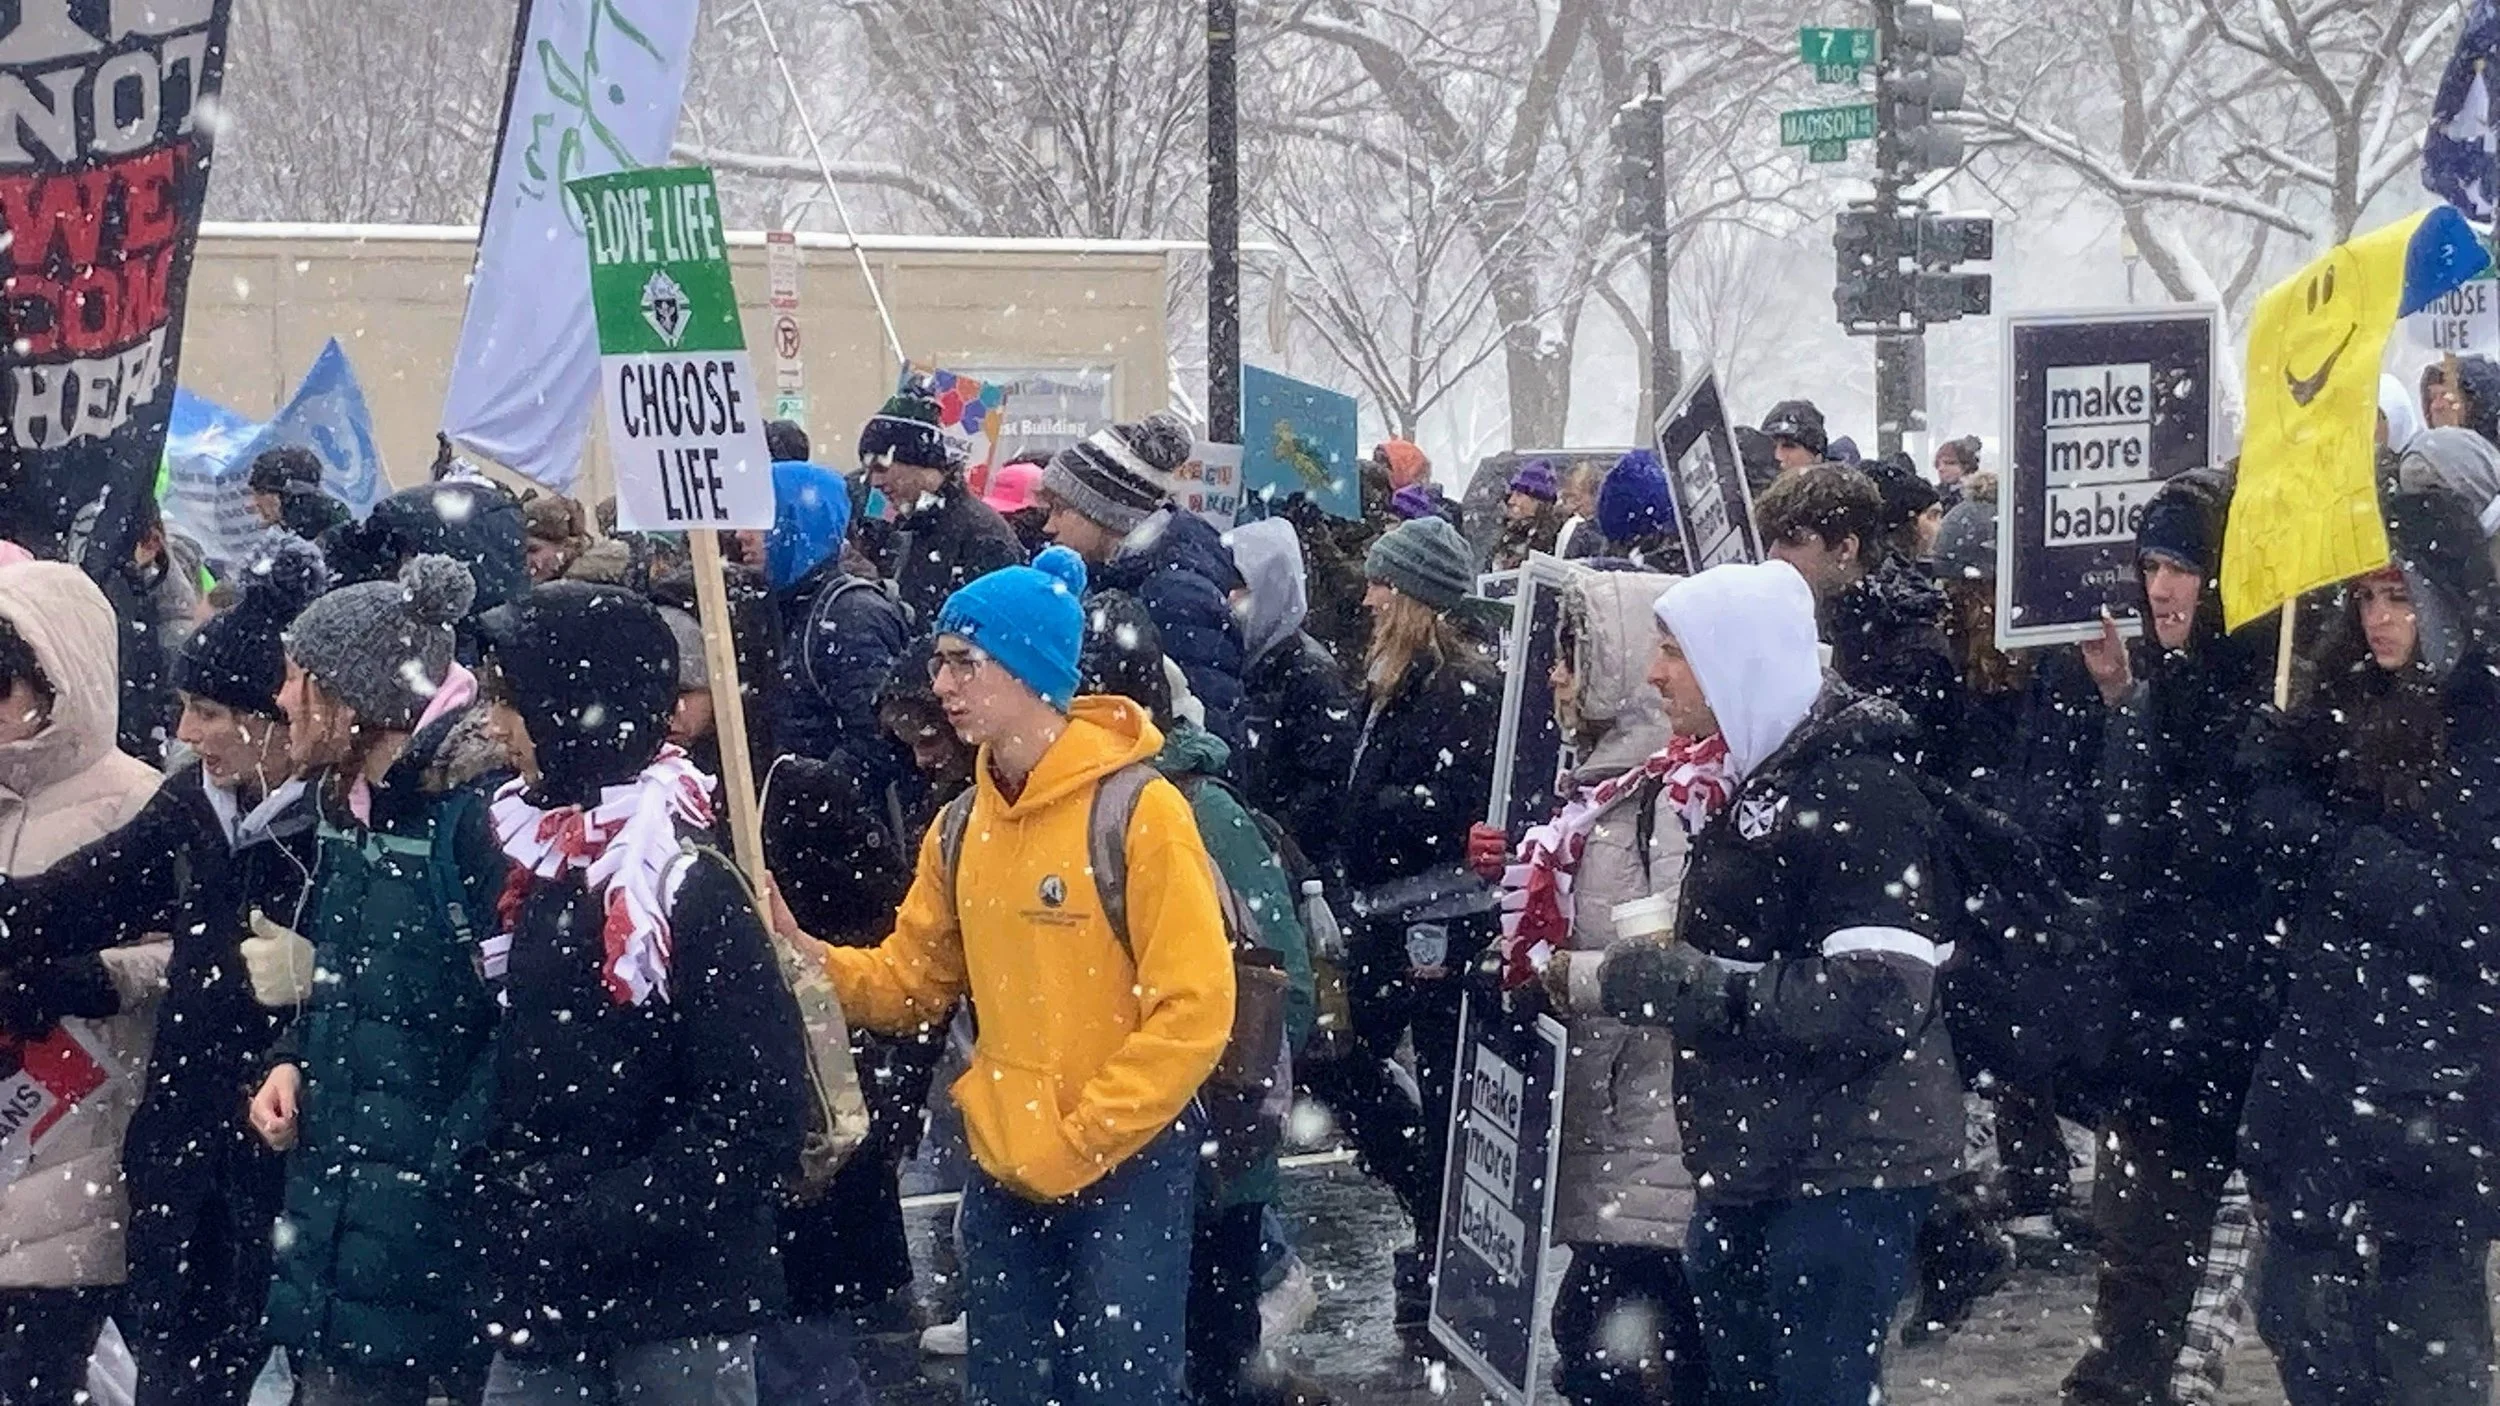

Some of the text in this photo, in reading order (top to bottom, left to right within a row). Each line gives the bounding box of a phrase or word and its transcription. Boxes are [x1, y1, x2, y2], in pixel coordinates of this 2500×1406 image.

[1818, 32, 1835, 58] 7
[1783, 109, 1857, 142] MADISON
[0, 148, 174, 264] WE
[583, 184, 722, 265] LOVE LIFE
[2418, 284, 2487, 316] OOSE
[2432, 318, 2470, 349] LIFE
[620, 360, 747, 439] CHOOSE
[2051, 370, 2144, 420] make
[1022, 419, 1086, 438] Building
[2050, 435, 2142, 472] more
[658, 447, 729, 521] LIFE
[2049, 491, 2146, 540] babie
[1475, 1067, 1519, 1130] make
[1468, 1127, 1512, 1188] more
